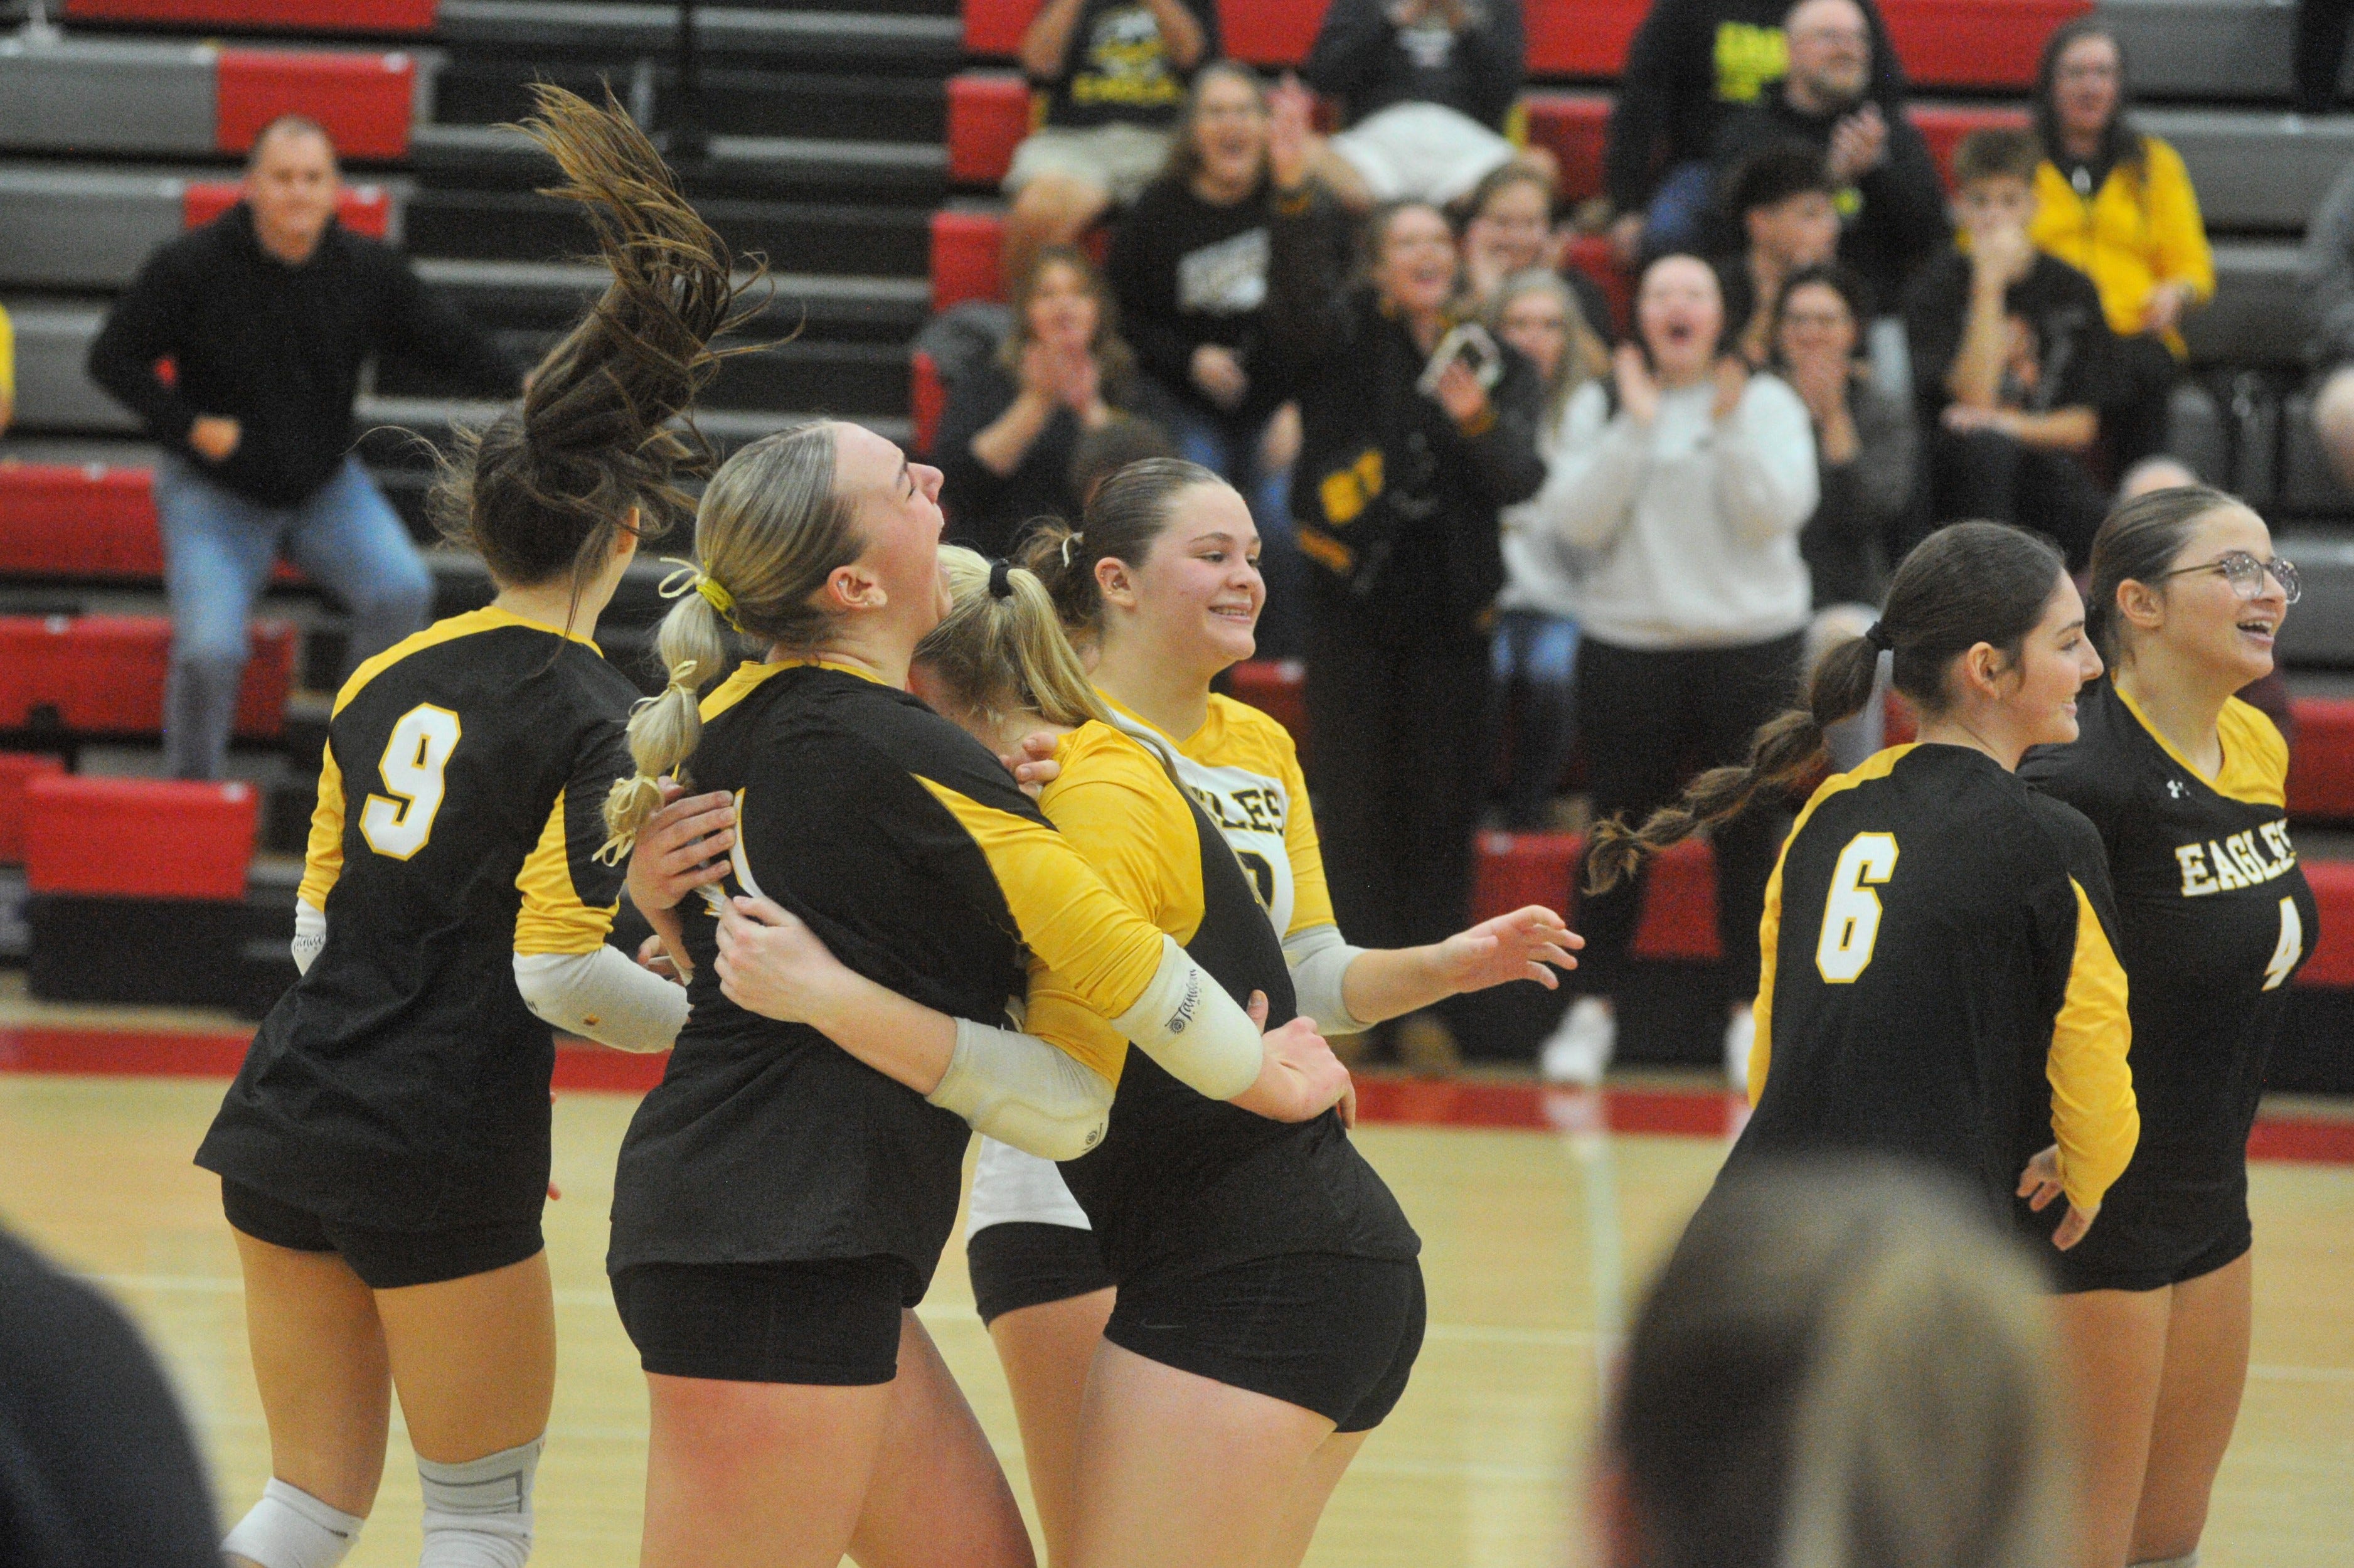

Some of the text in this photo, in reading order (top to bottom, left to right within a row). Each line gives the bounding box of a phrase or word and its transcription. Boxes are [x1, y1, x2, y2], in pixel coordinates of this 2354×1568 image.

[359, 702, 462, 861] 9
[1191, 786, 1284, 837] LES
[1816, 831, 1900, 983] 6
